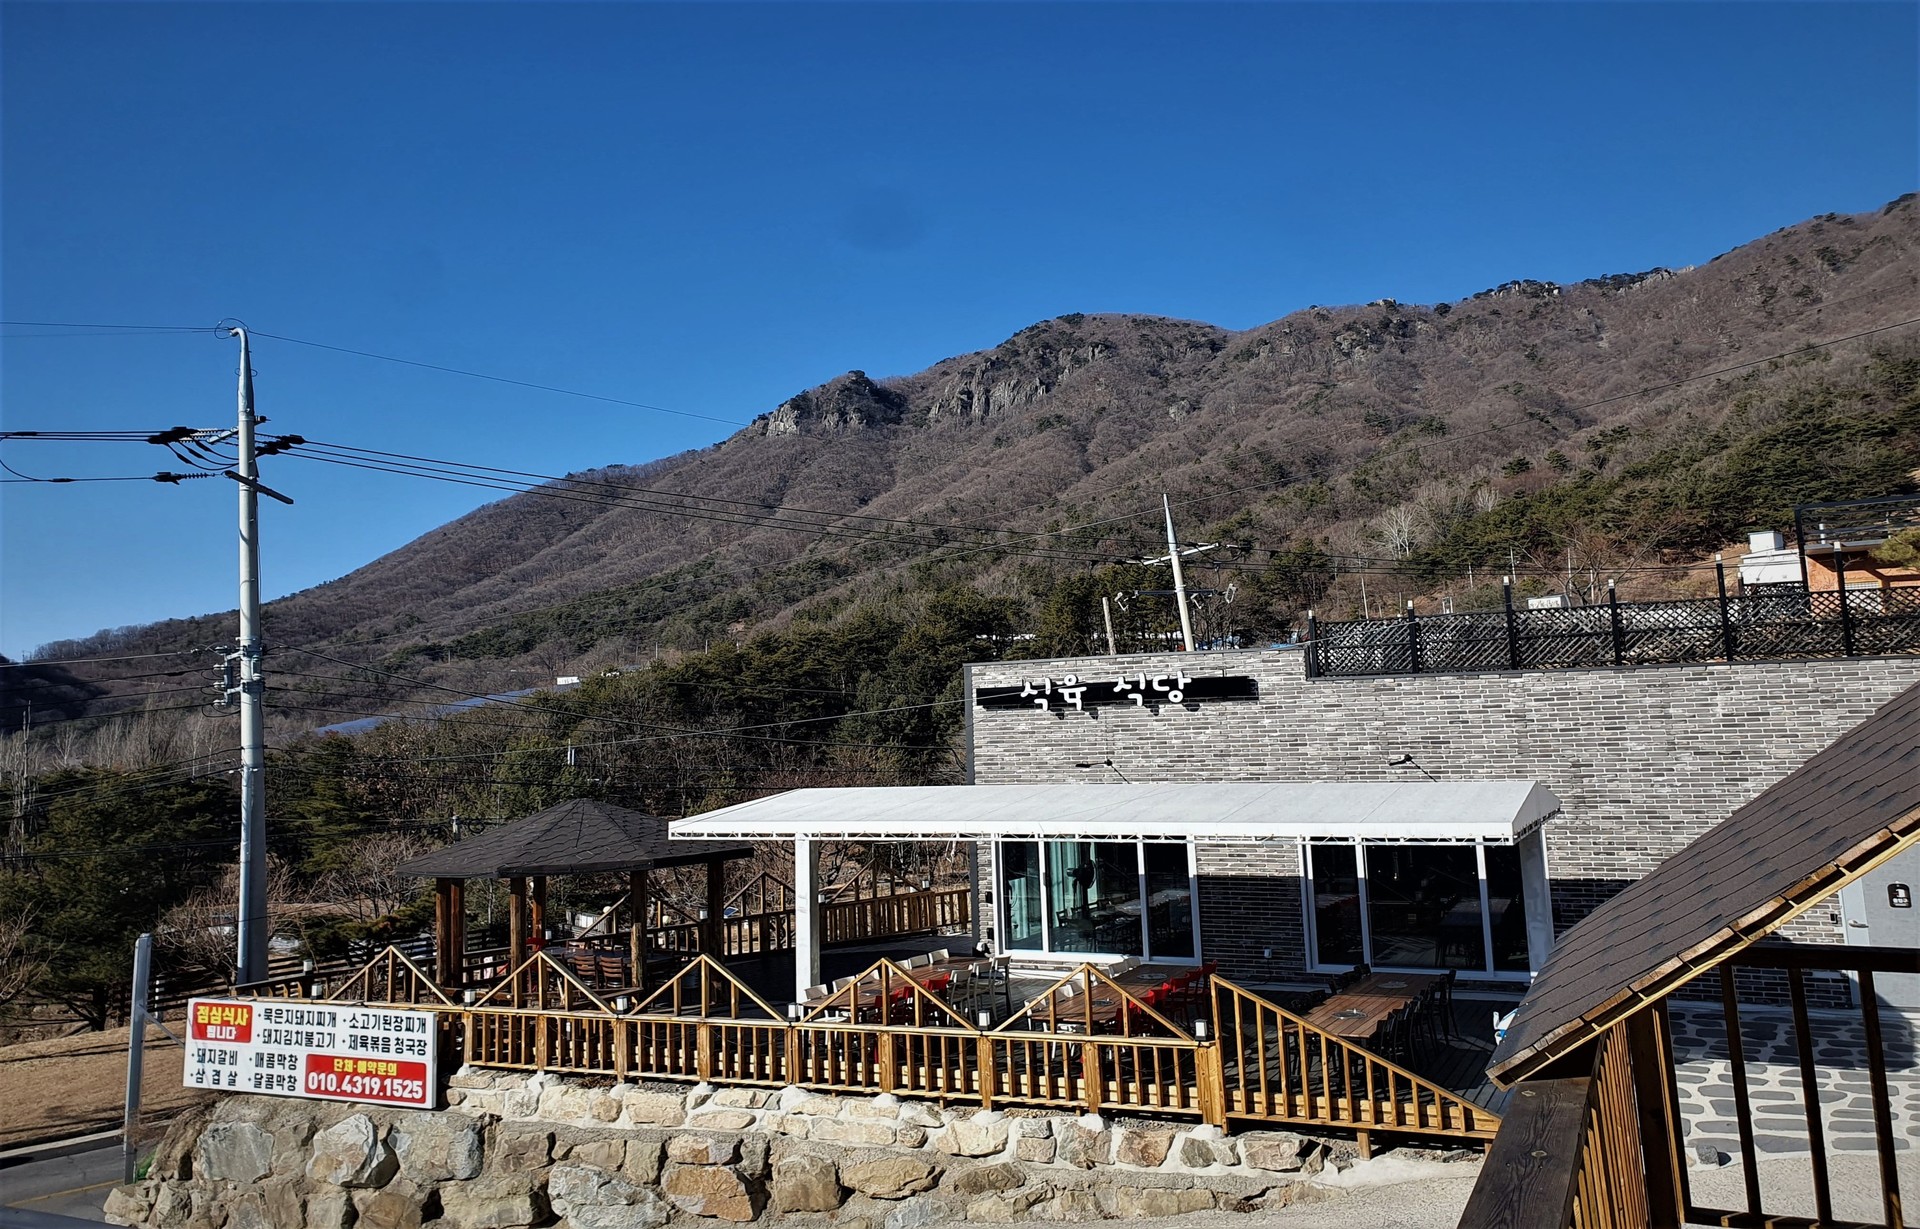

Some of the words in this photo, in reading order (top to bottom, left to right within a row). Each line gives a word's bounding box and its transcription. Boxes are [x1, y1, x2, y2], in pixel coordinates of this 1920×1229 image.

[1020, 674, 1087, 711] 식육
[1113, 670, 1192, 706] 식당
[197, 1005, 248, 1026] 점심식사
[264, 1008, 337, 1028] 묵은지돼지찌개
[349, 1013, 427, 1034] 소고기된장찌개
[262, 1028, 336, 1049] 돼지김치불고기
[348, 1034, 391, 1053] 제육볶음
[394, 1036, 428, 1056] 청국장
[196, 1048, 238, 1066] 돼지갈비
[255, 1052, 298, 1071] 매콤막창
[253, 1073, 298, 1092] 달콤막창
[308, 1072, 423, 1099] 010.4319.1525
